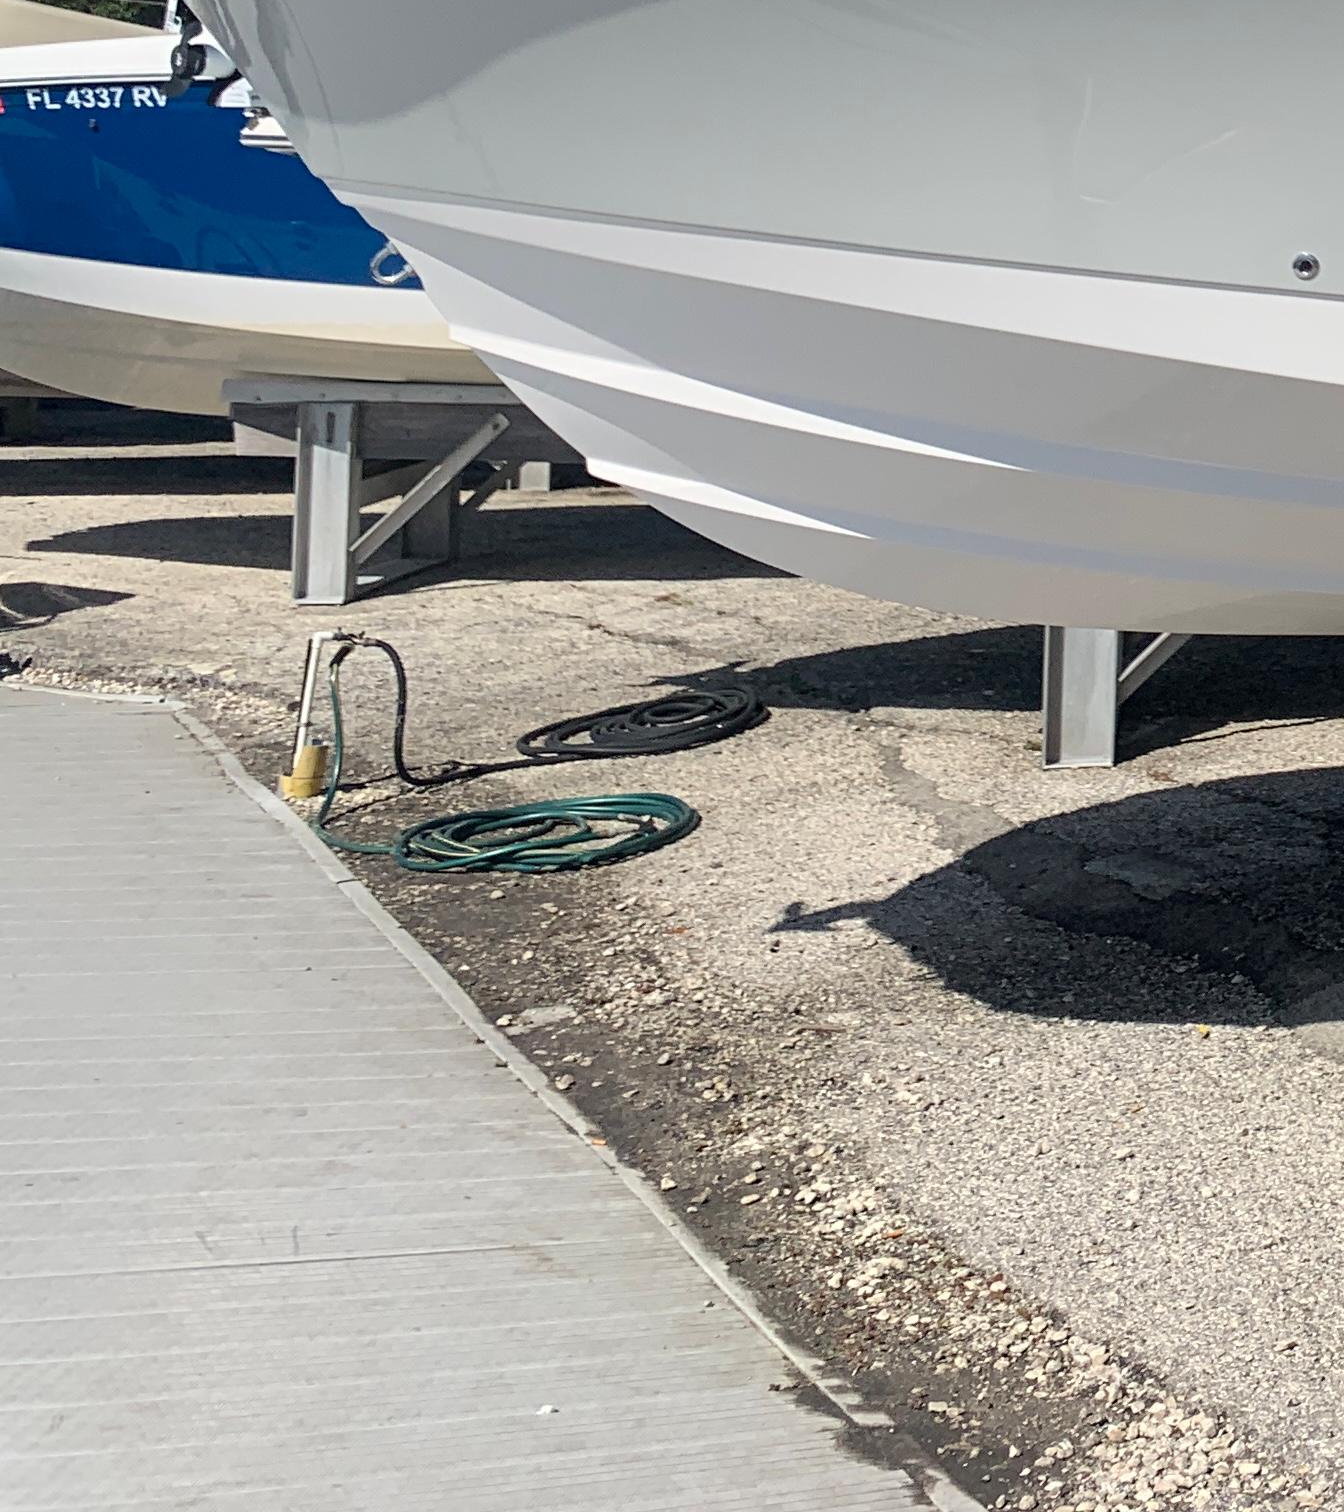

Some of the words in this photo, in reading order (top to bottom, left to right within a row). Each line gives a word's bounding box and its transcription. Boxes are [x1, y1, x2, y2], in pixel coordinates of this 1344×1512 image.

[26, 89, 61, 110] FL
[65, 88, 124, 109] 4337
[132, 87, 168, 108] RV
